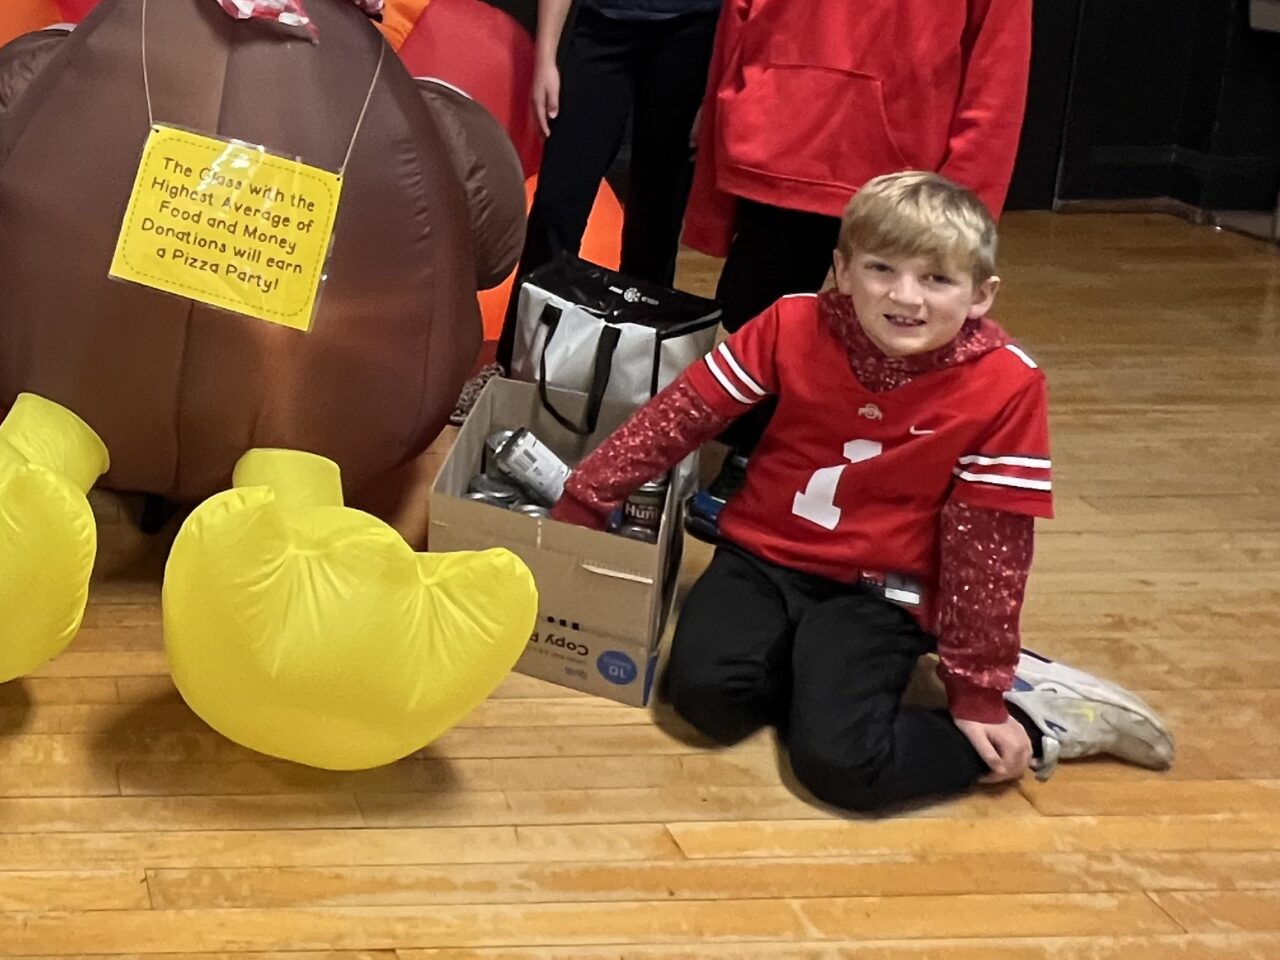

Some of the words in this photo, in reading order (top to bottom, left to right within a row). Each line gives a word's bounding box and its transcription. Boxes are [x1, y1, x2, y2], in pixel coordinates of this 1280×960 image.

[151, 177, 214, 206] Highest
[221, 197, 290, 228] Average
[297, 220, 315, 233] of
[163, 156, 193, 178] The
[199, 167, 243, 190] Class
[249, 181, 285, 203] with
[290, 192, 315, 212] the
[141, 218, 226, 253] Donations
[233, 243, 261, 264] will
[266, 255, 303, 274] earn
[159, 200, 201, 224] Food
[207, 217, 237, 235] and
[243, 225, 297, 255] Money
[156, 247, 166, 259] a
[172, 249, 219, 274] Pizza
[226, 264, 279, 294] Party!
[792, 438, 883, 531] 1
[545, 633, 590, 657] Copy
